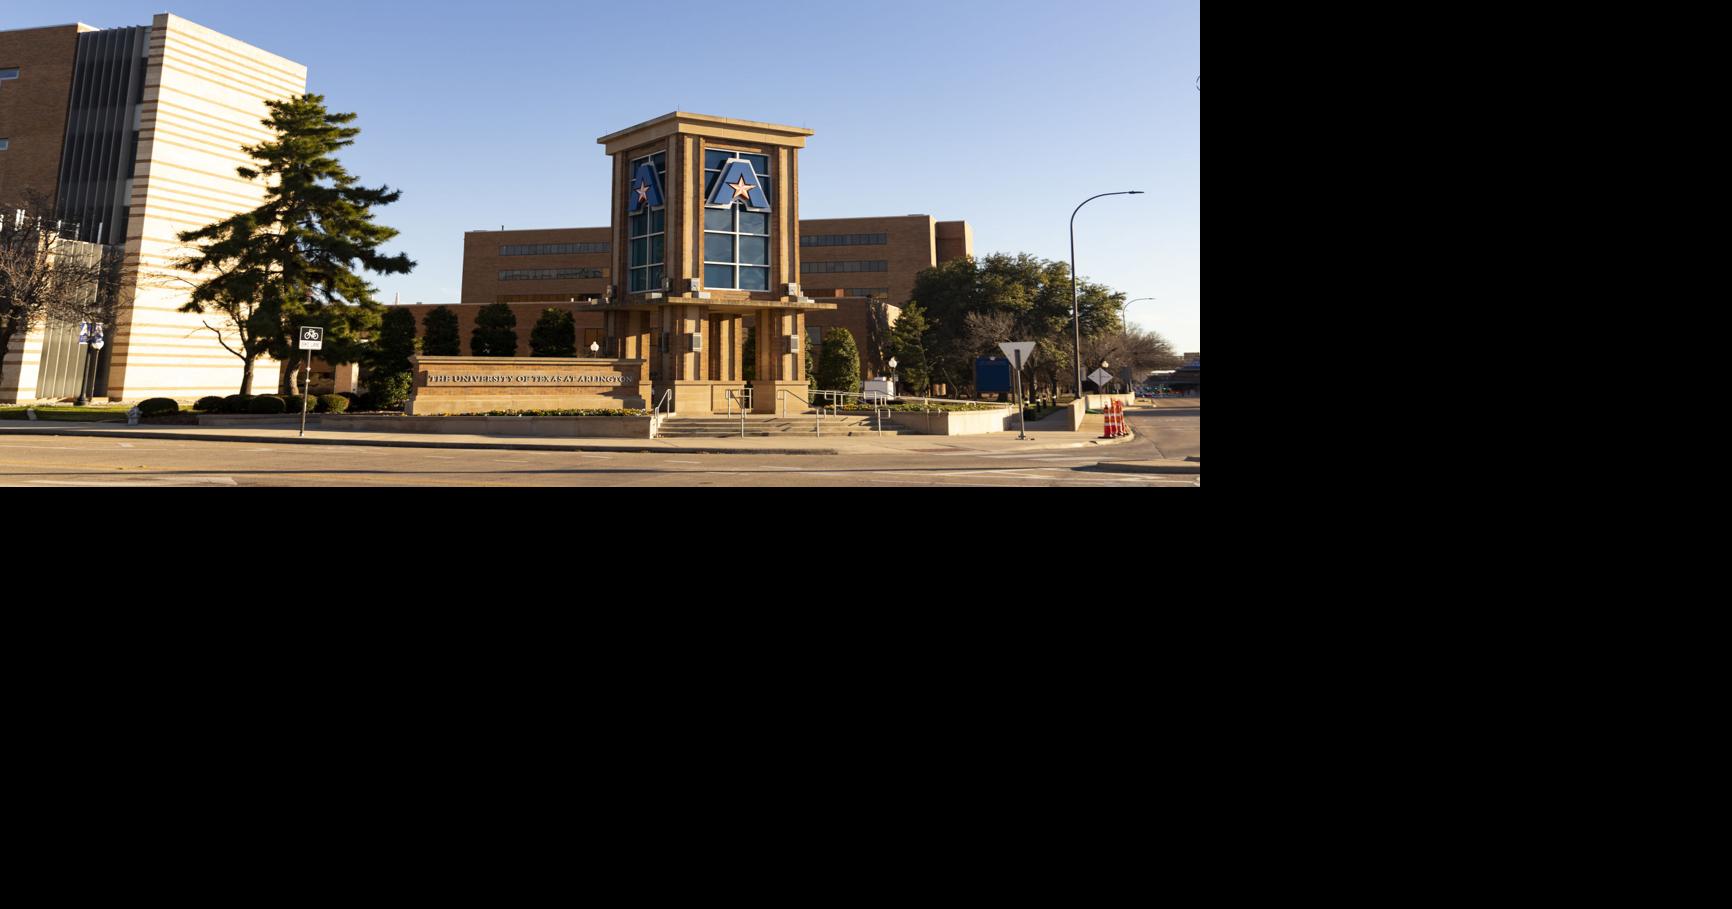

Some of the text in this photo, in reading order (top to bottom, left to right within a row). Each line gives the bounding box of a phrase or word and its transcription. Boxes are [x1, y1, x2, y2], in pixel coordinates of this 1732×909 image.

[428, 375, 632, 383] THE UNIVERSITY OF TEXAS AT ARLINGTON
